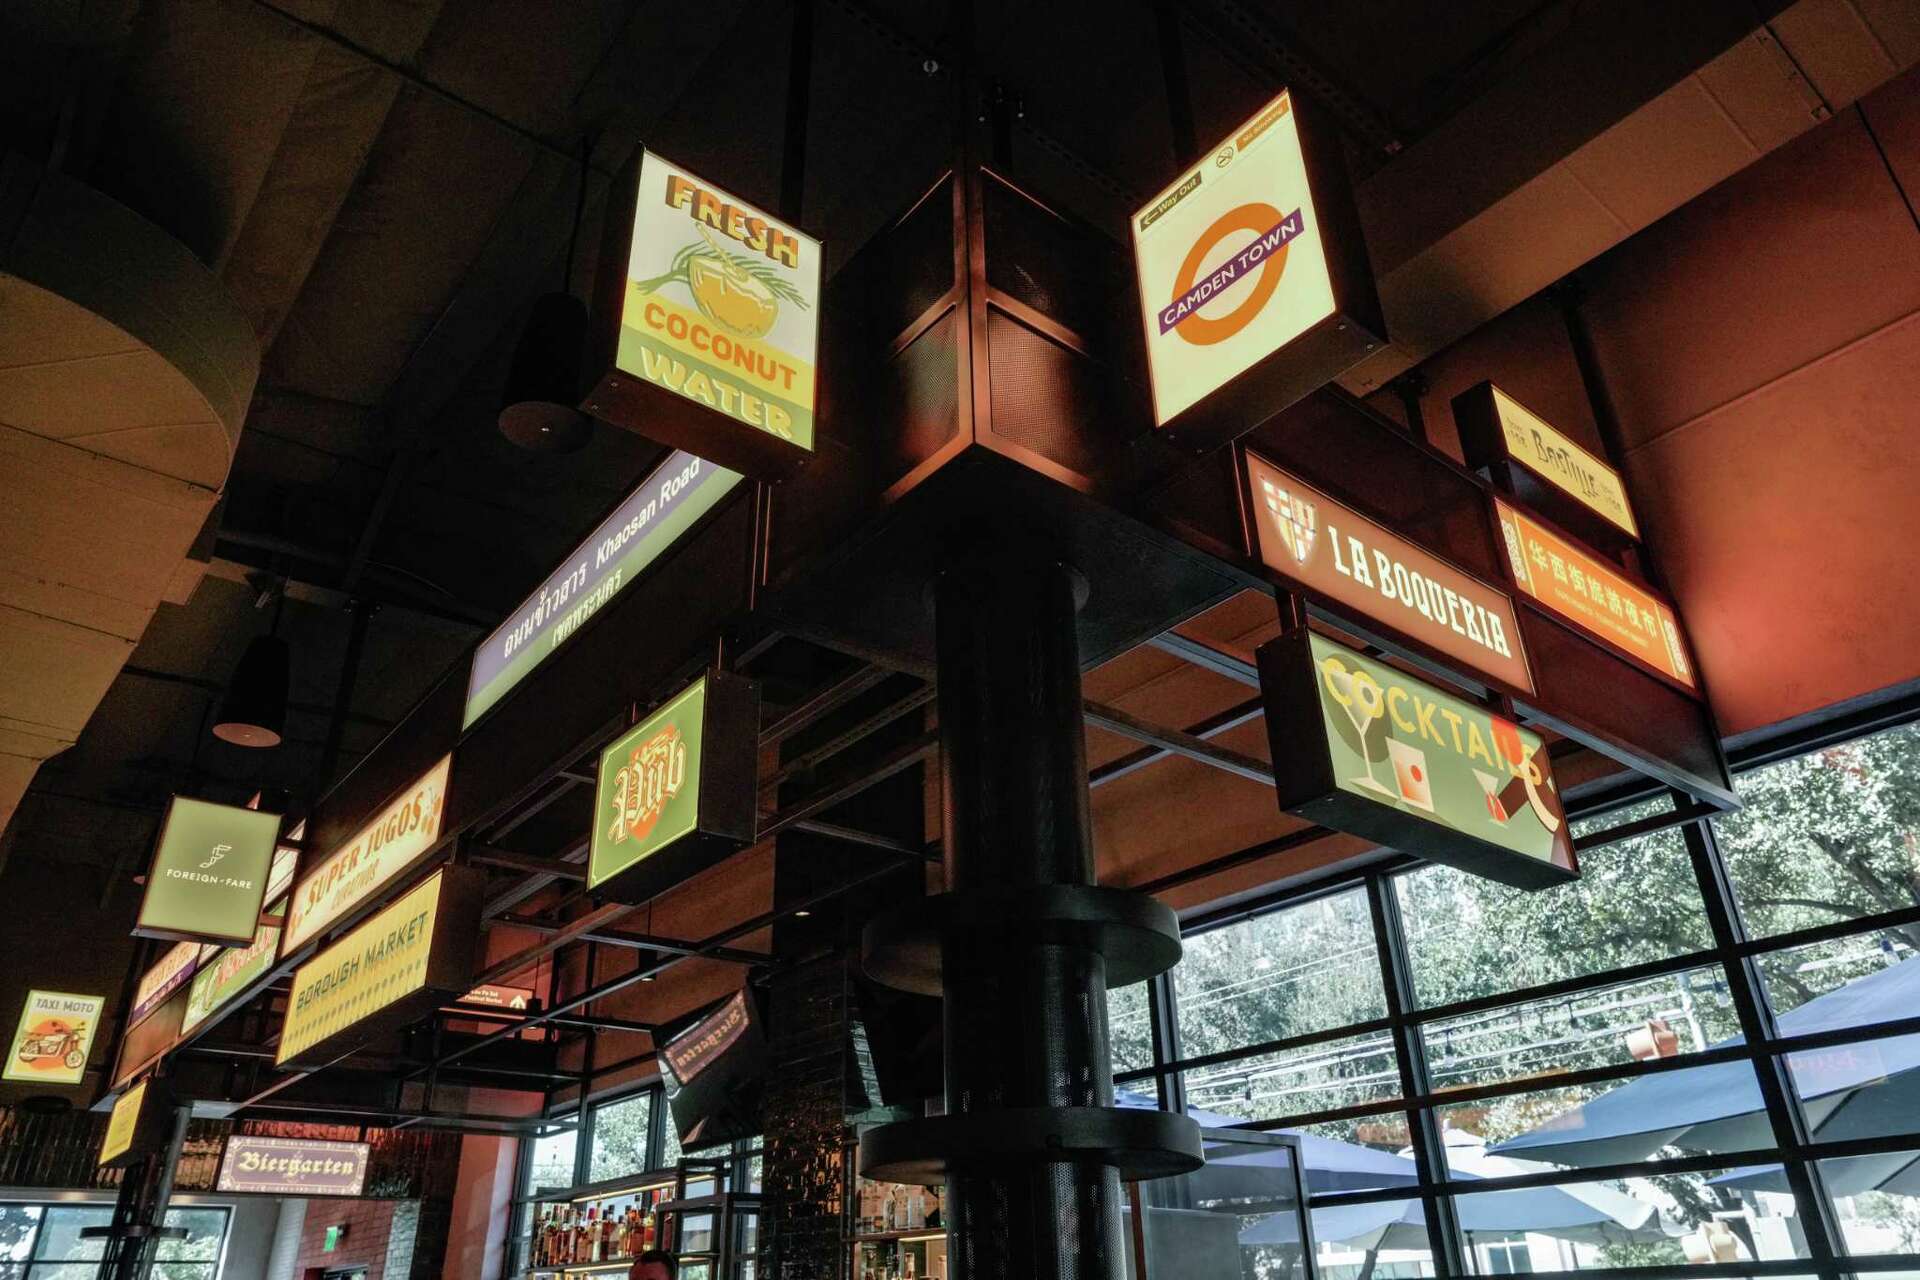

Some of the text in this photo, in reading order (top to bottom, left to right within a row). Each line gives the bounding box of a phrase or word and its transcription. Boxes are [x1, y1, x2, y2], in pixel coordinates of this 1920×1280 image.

[665, 174, 799, 269] FRESH
[1159, 178, 1196, 212] Way Out
[1164, 217, 1298, 326] CAMDEN TOWN
[640, 346, 793, 439] WATER
[644, 302, 797, 390] COCONUT
[596, 498, 656, 569] Khaosan
[660, 456, 701, 508] Road
[1328, 525, 1374, 588] LA
[1373, 548, 1512, 658] BOQUERIA
[1319, 657, 1542, 786] COCKTAILS
[608, 730, 686, 845] Pub
[304, 791, 424, 915] SUPER JUGOS
[36, 998, 95, 1013] TAXI MOTO
[296, 953, 361, 1010] BOROUGH
[364, 911, 428, 970] MARKET
[238, 1151, 354, 1178] Biergarten
